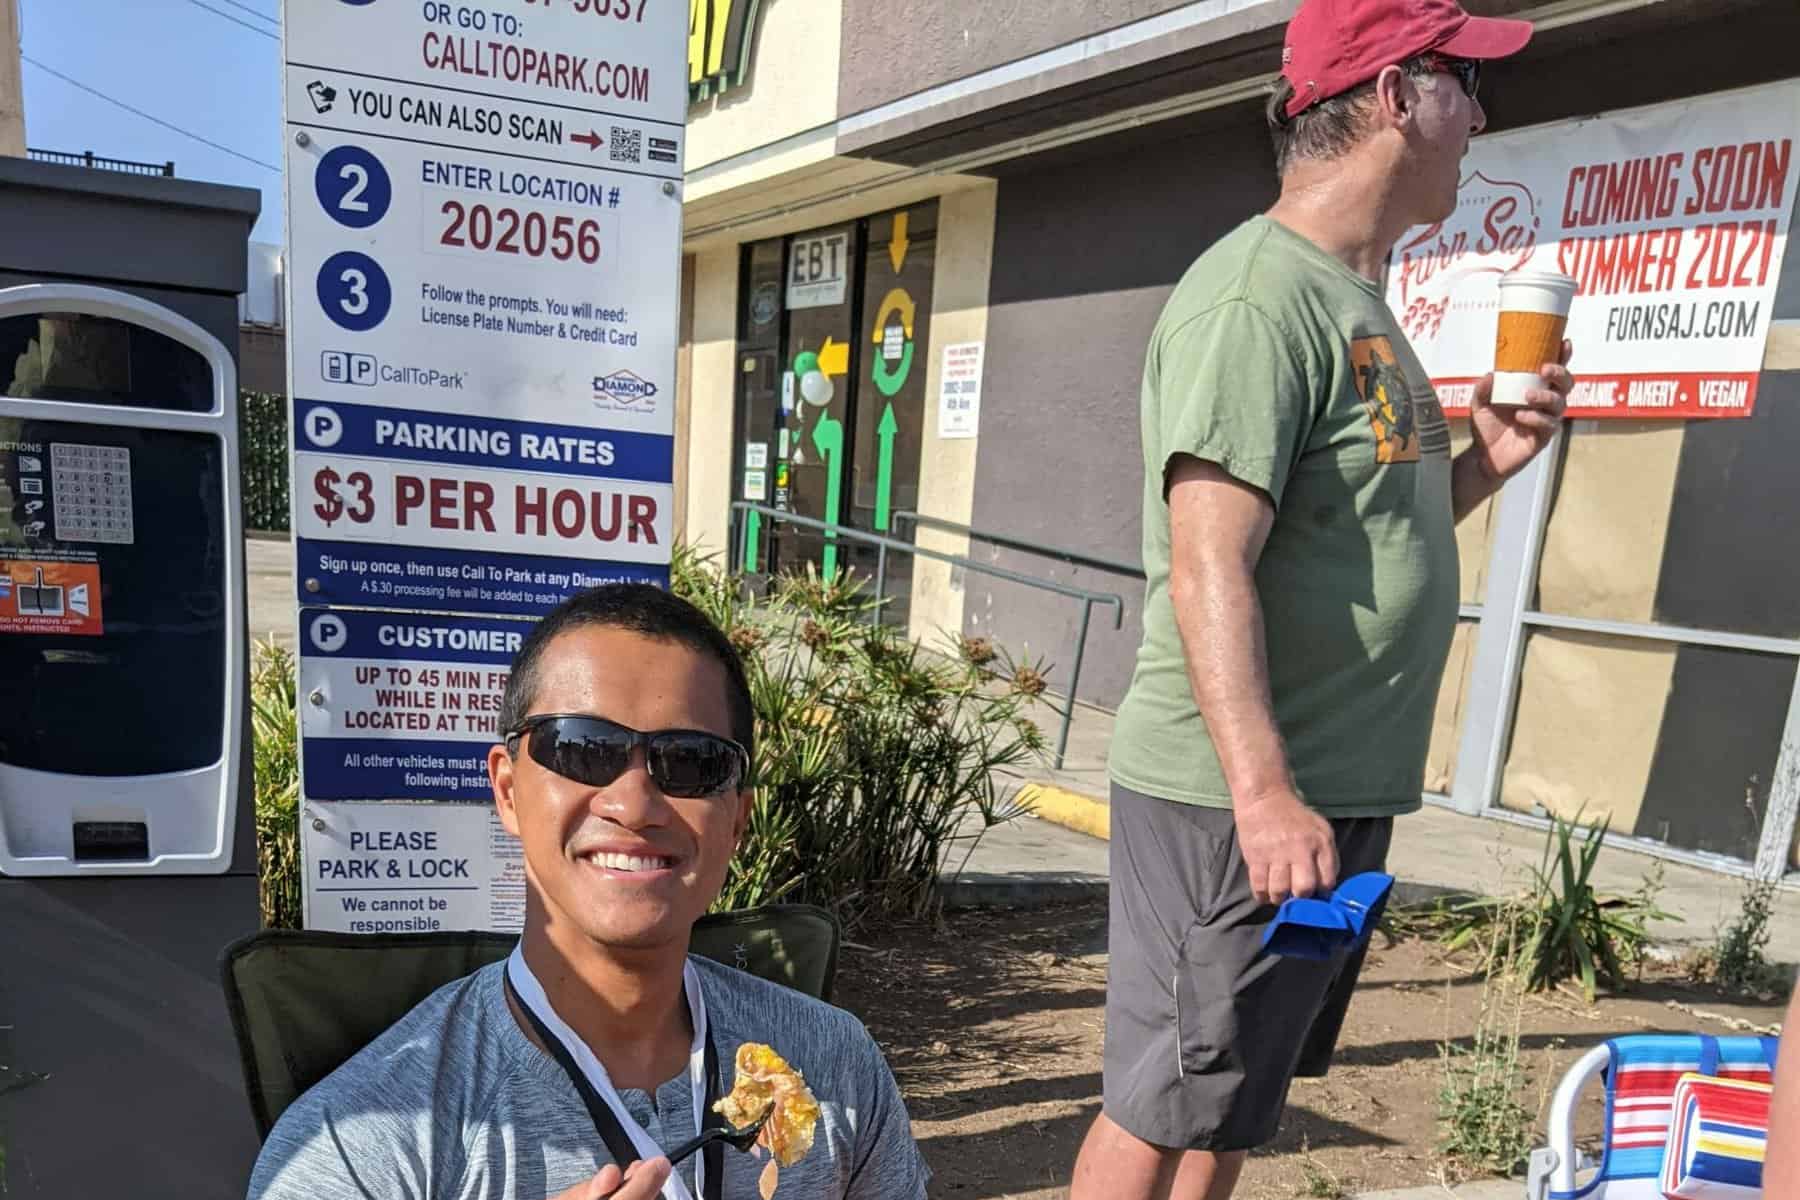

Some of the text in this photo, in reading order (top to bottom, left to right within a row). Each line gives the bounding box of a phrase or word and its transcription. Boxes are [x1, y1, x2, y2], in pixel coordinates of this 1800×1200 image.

[424, 1, 523, 37] OR GO TO:
[423, 31, 649, 102] CALLTOPARK.COM
[348, 88, 563, 145] YOU CAN ALSO SCAN
[339, 164, 369, 212] 2
[422, 160, 492, 191] ENTER
[499, 174, 601, 206] LOCATION
[1561, 139, 1792, 229] COMING SOON
[440, 200, 601, 264] 202056
[1476, 196, 1540, 272] Saj
[793, 237, 844, 283] EBT
[1557, 219, 1778, 297] SUMMER 2021
[340, 268, 369, 315] 3
[422, 284, 462, 304] Follow
[466, 289, 485, 306] the
[489, 294, 542, 318] prompts.
[545, 298, 568, 318] You
[571, 301, 593, 319] will
[422, 309, 637, 346] License Plate Number & Credit Card
[1606, 300, 1760, 343] FURNSAJ.COM
[380, 365, 464, 389] CallToPark
[1628, 381, 1679, 408] BAKERY
[1700, 381, 1749, 407] VEGAN
[375, 419, 615, 466] PARKING RATES
[314, 466, 658, 545] $3 PER HOUR
[320, 555, 348, 574] Sign
[351, 560, 367, 576] up
[370, 561, 404, 577] once,
[407, 562, 434, 577] then
[437, 566, 459, 578] use
[462, 565, 485, 580] Call
[488, 567, 502, 581] To
[505, 568, 532, 584] Park
[534, 572, 546, 585] at
[549, 574, 570, 588] any
[361, 581, 369, 592] A
[394, 583, 445, 601] processing
[447, 587, 462, 599] fee
[464, 587, 478, 600] will
[480, 589, 492, 601] be
[494, 589, 522, 603] added
[524, 592, 533, 603] to
[536, 593, 559, 605] each
[378, 625, 523, 652] CUSTOMER
[356, 666, 512, 690] UP TO 45 MIN FR
[376, 690, 503, 711] WHILE IN RES
[345, 711, 497, 733] LOCATED AT THI
[344, 753, 360, 767] All
[363, 754, 394, 767] other
[397, 755, 445, 769] vehicles
[448, 757, 477, 769] must
[405, 773, 458, 790] following
[350, 831, 437, 852] PLEASE
[318, 859, 469, 880] PARK & LOCK
[341, 897, 447, 913] We cannot be
[349, 915, 440, 932] responsible
